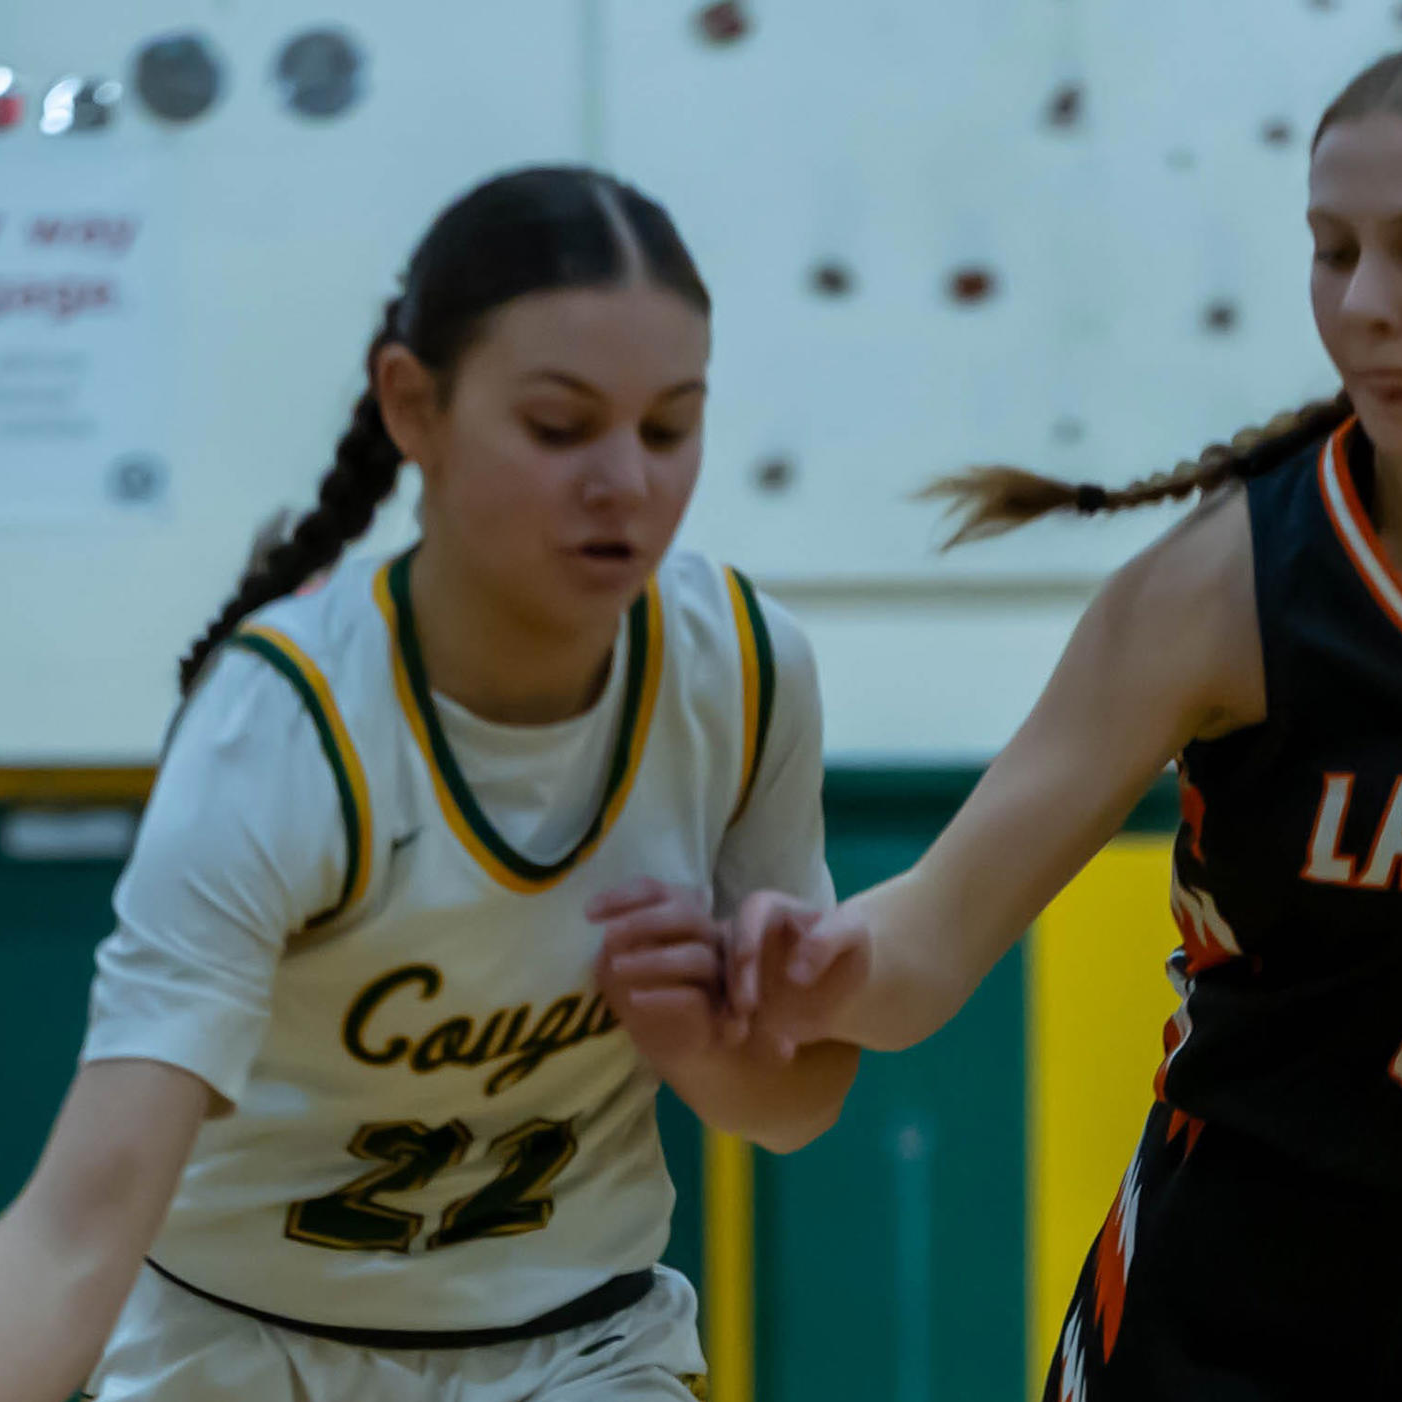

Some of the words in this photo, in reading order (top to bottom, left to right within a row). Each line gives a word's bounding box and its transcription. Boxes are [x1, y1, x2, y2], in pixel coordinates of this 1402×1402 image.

[28, 217, 141, 261] way
[341, 962, 621, 1097] Couga
[282, 1116, 580, 1254] 22
